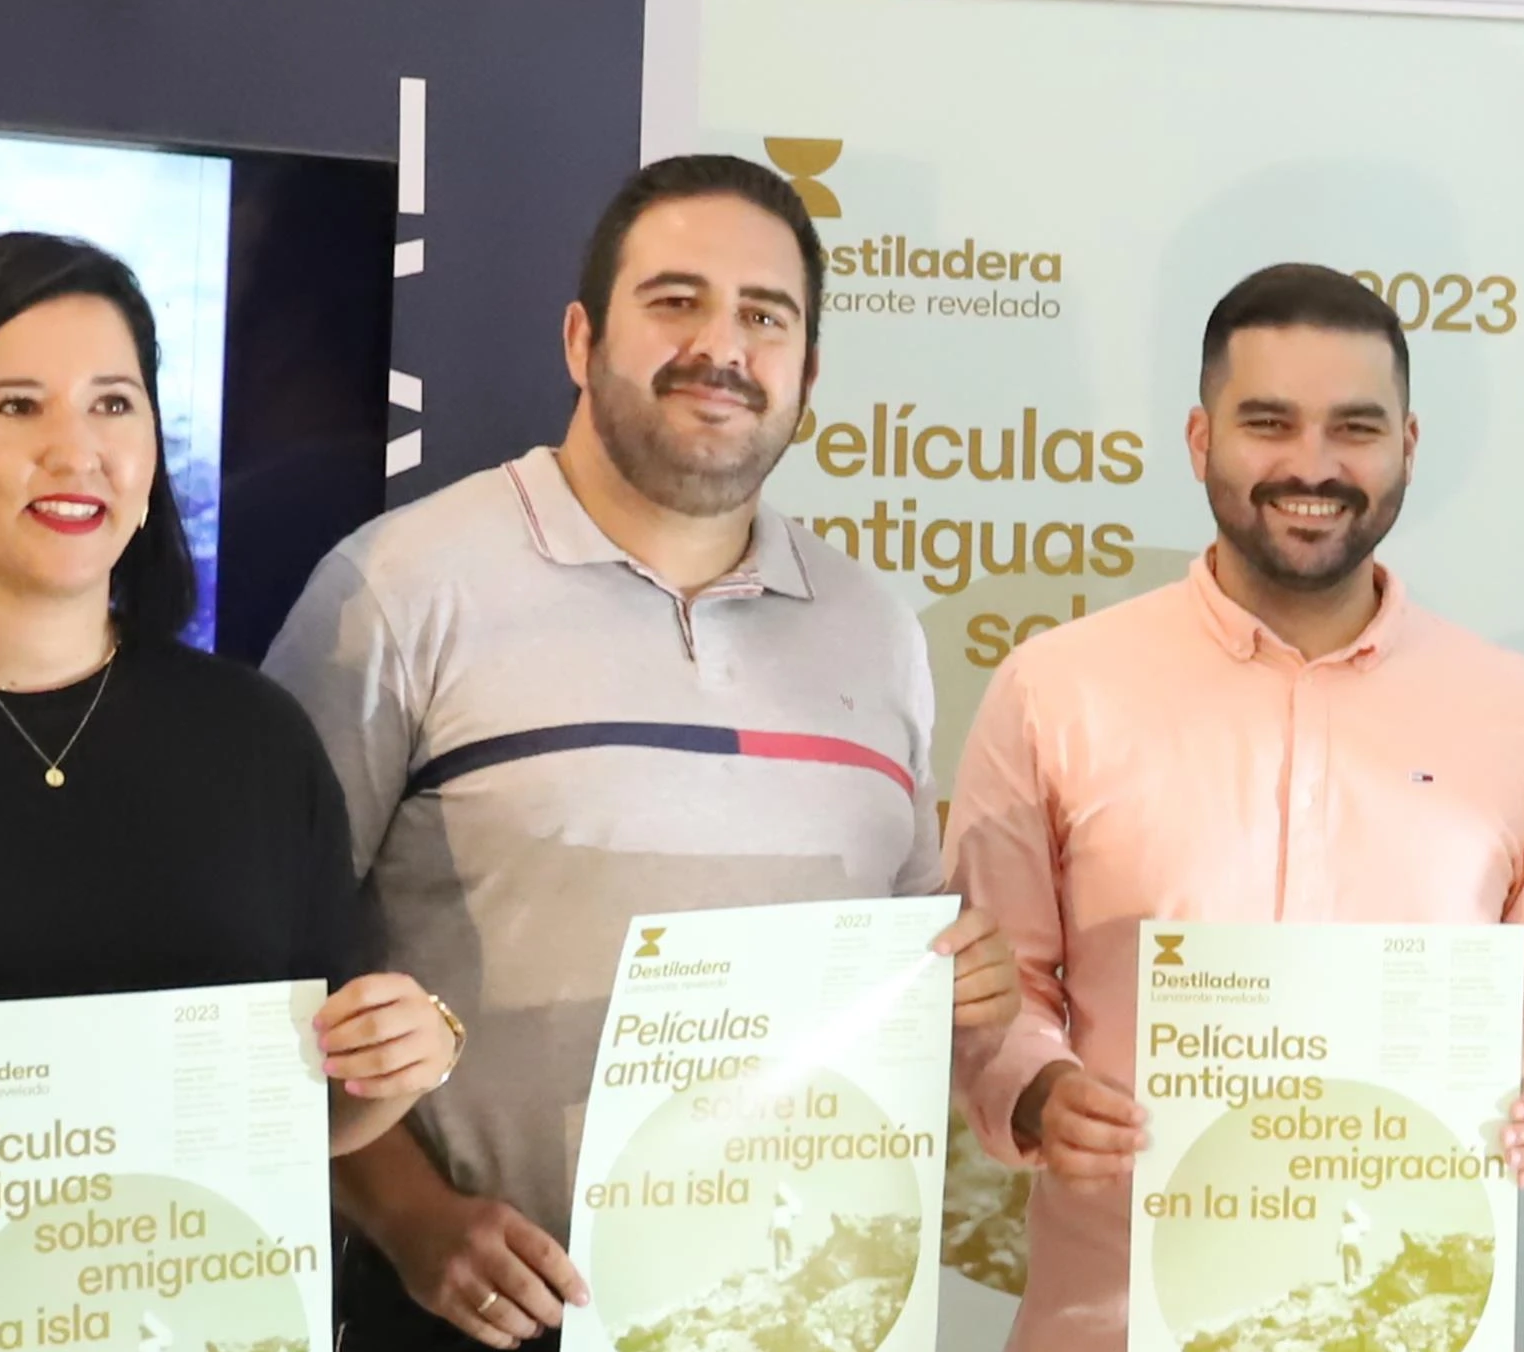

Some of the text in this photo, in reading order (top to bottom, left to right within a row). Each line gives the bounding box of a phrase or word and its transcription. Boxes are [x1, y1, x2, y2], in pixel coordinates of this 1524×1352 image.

[822, 235, 1062, 284] stiladera
[821, 288, 1062, 320] zarote revelado
[793, 498, 1136, 595] ntiguas
[833, 912, 872, 930] 2023
[1383, 937, 1426, 954] 2023
[627, 959, 731, 981] Destiladera
[1151, 970, 1271, 991] Destiladera
[174, 1004, 220, 1024] 2023
[613, 1008, 771, 1048] Películas
[1149, 1022, 1328, 1061] Películas
[603, 1051, 763, 1093] antiguas
[1147, 1065, 1324, 1111] antiguas
[805, 1086, 839, 1120] la
[1250, 1104, 1408, 1142] sobre la
[724, 1123, 935, 1171] emigración
[1287, 1146, 1506, 1192] emigración
[584, 1169, 750, 1211] en la isla
[1143, 1183, 1317, 1221] en la isla
[34, 1201, 206, 1254] sobre la
[78, 1236, 318, 1298] emigración
[36, 1303, 111, 1345] isla
